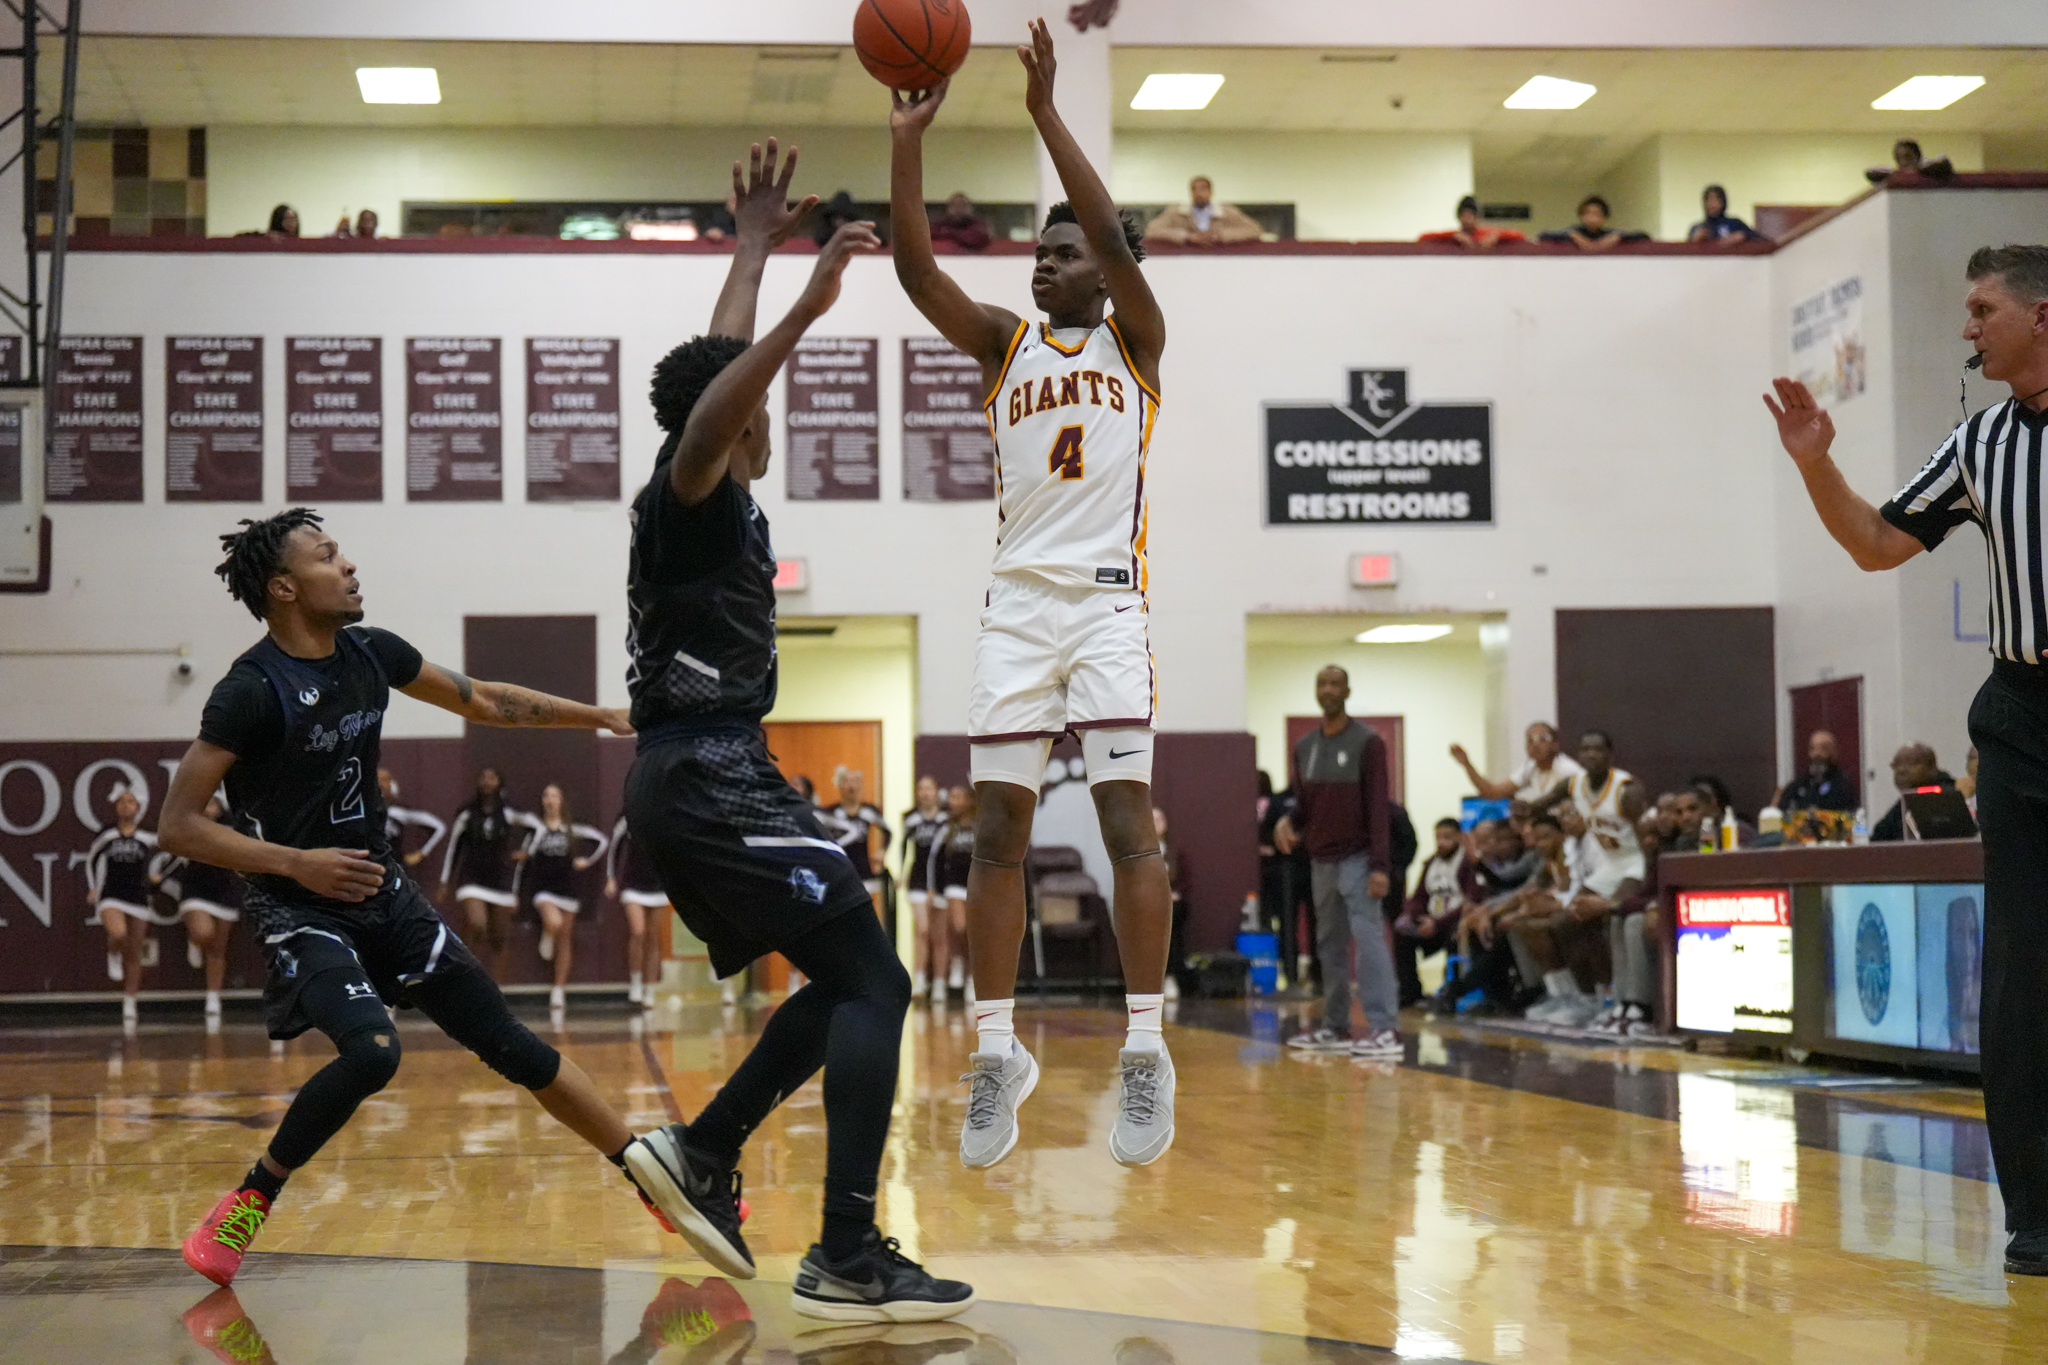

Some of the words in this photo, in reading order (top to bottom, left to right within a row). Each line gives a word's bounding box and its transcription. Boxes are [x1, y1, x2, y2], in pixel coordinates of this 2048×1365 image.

[73, 393, 117, 408] STATE
[194, 392, 238, 408] STATE
[313, 392, 357, 408] STATE
[433, 393, 477, 409] STATE
[552, 393, 596, 409] STATE
[811, 392, 855, 409] STATE
[926, 392, 971, 408] STATE
[1009, 370, 1125, 427] GIANTS
[170, 411, 261, 427] CHAMPIONS
[290, 411, 380, 427] CHAMPIONS
[409, 411, 499, 428] CHAMPIONS
[529, 411, 618, 428] CHAMPIONS
[787, 411, 877, 427] CHAMPIONS
[1048, 424, 1084, 481] 4
[1274, 439, 1482, 467] CONCESSIONS
[1288, 492, 1470, 520] RESTROOMS
[330, 757, 365, 824] 2
